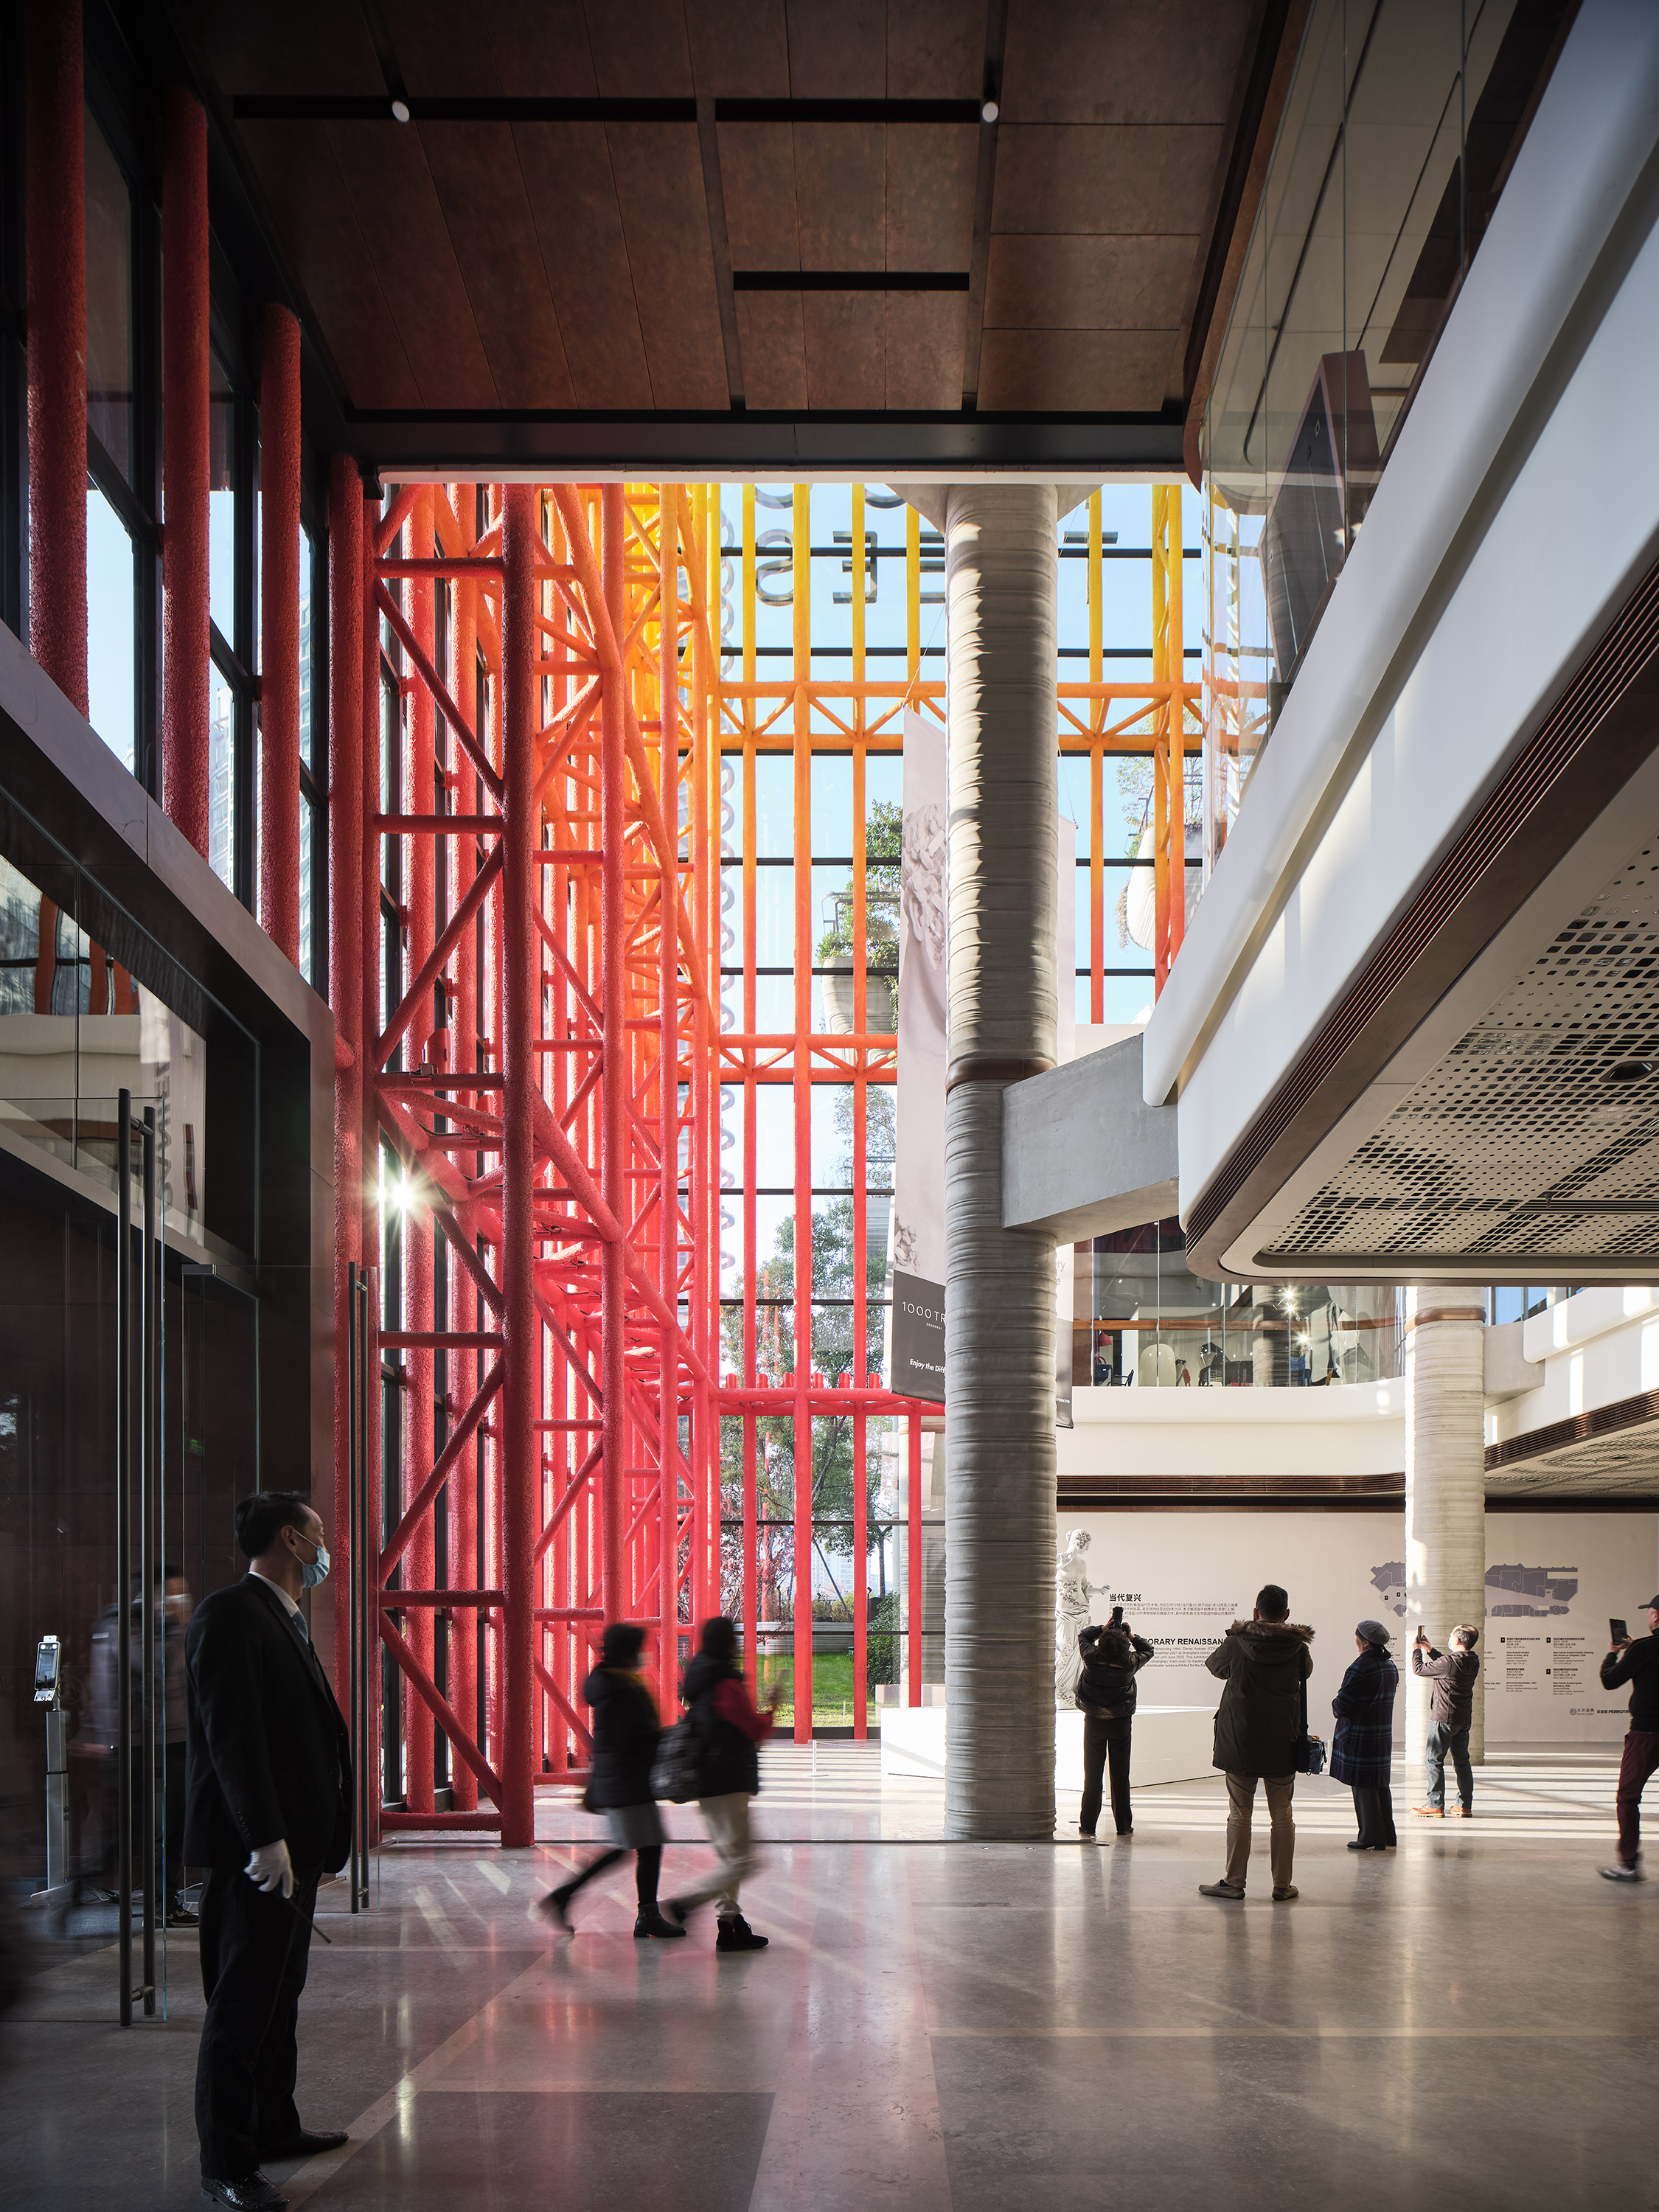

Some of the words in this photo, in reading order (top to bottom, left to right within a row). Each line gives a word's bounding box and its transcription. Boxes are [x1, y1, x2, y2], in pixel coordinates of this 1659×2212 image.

[902, 1301, 932, 1319] 1000
[933, 1310, 946, 1323] TR
[909, 1358, 925, 1370] Enjoy
[925, 1362, 935, 1371] the
[935, 1365, 946, 1374] Diff
[1109, 1593, 1141, 1601] 当代复兴
